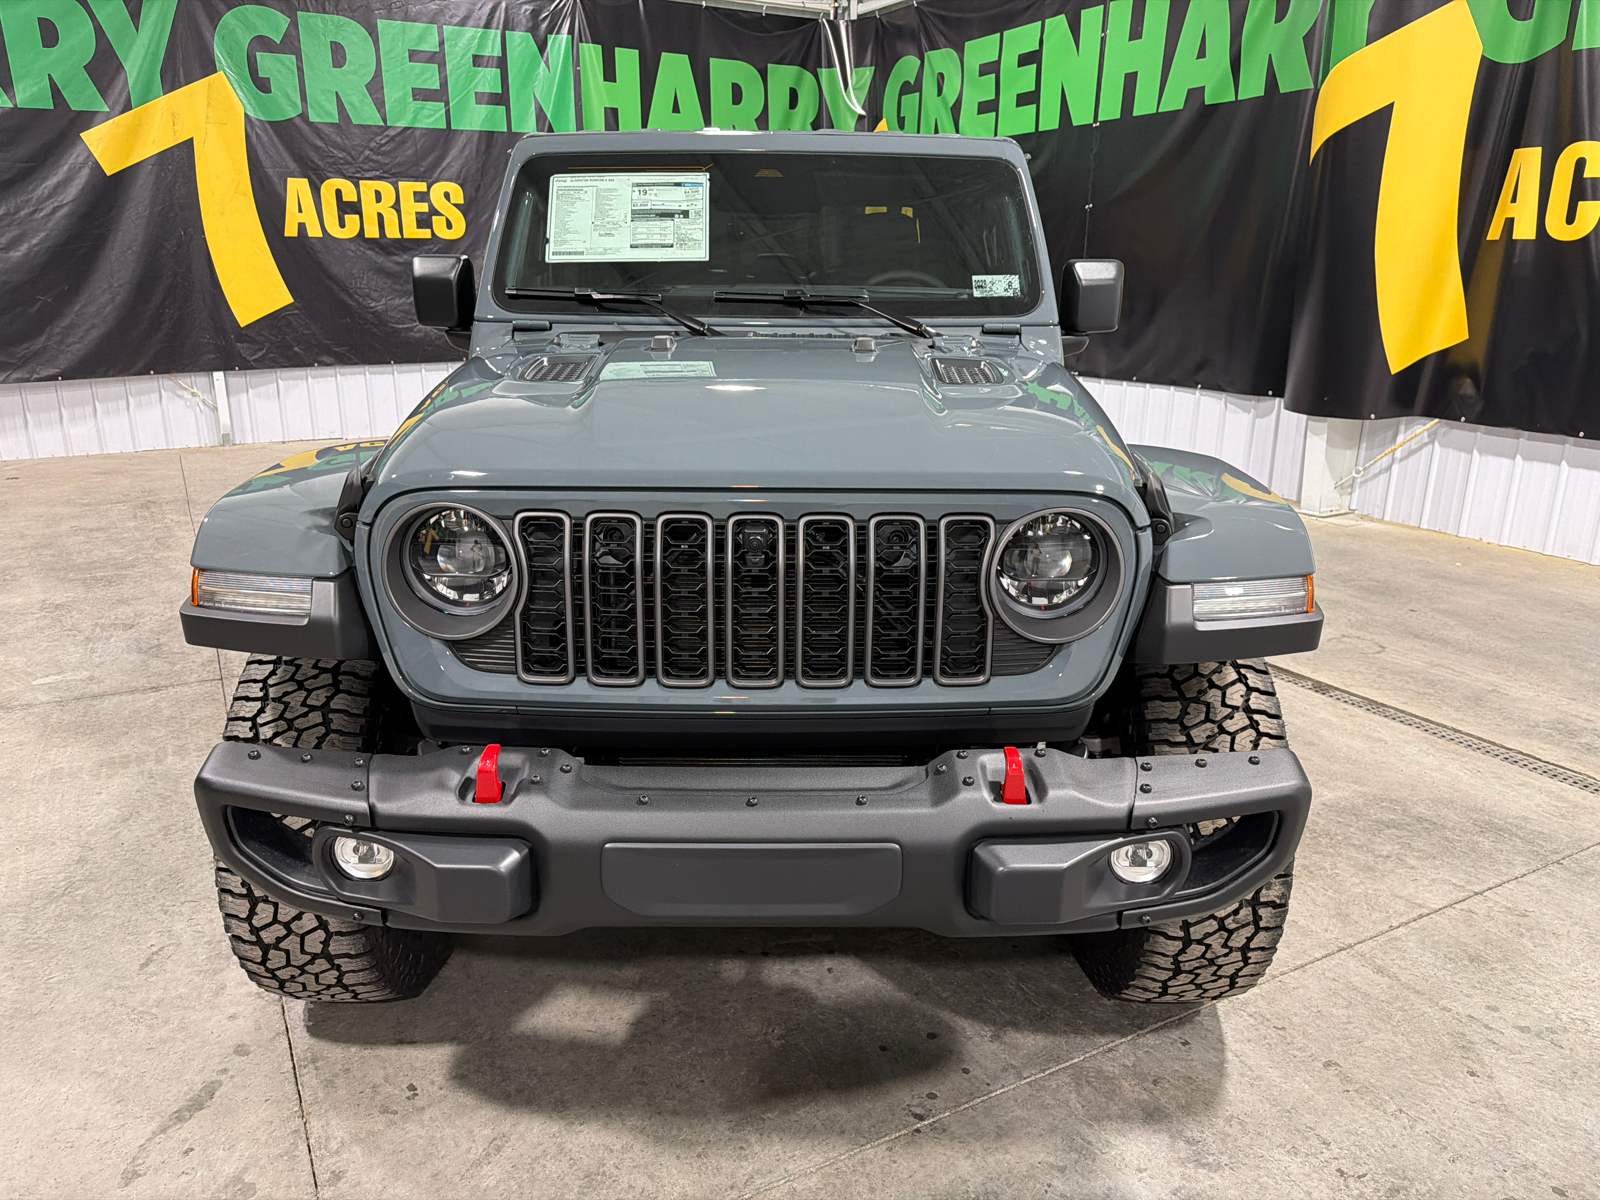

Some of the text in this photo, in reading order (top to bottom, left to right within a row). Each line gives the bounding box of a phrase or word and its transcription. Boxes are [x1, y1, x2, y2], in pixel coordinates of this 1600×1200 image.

[0, 0, 577, 133] RY GREEN
[580, 5, 1104, 138] HARRY GREEN
[80, 72, 294, 327] 7
[285, 177, 466, 239] ACRES
[637, 188, 648, 196] 19
[1310, 0, 1483, 375] 7
